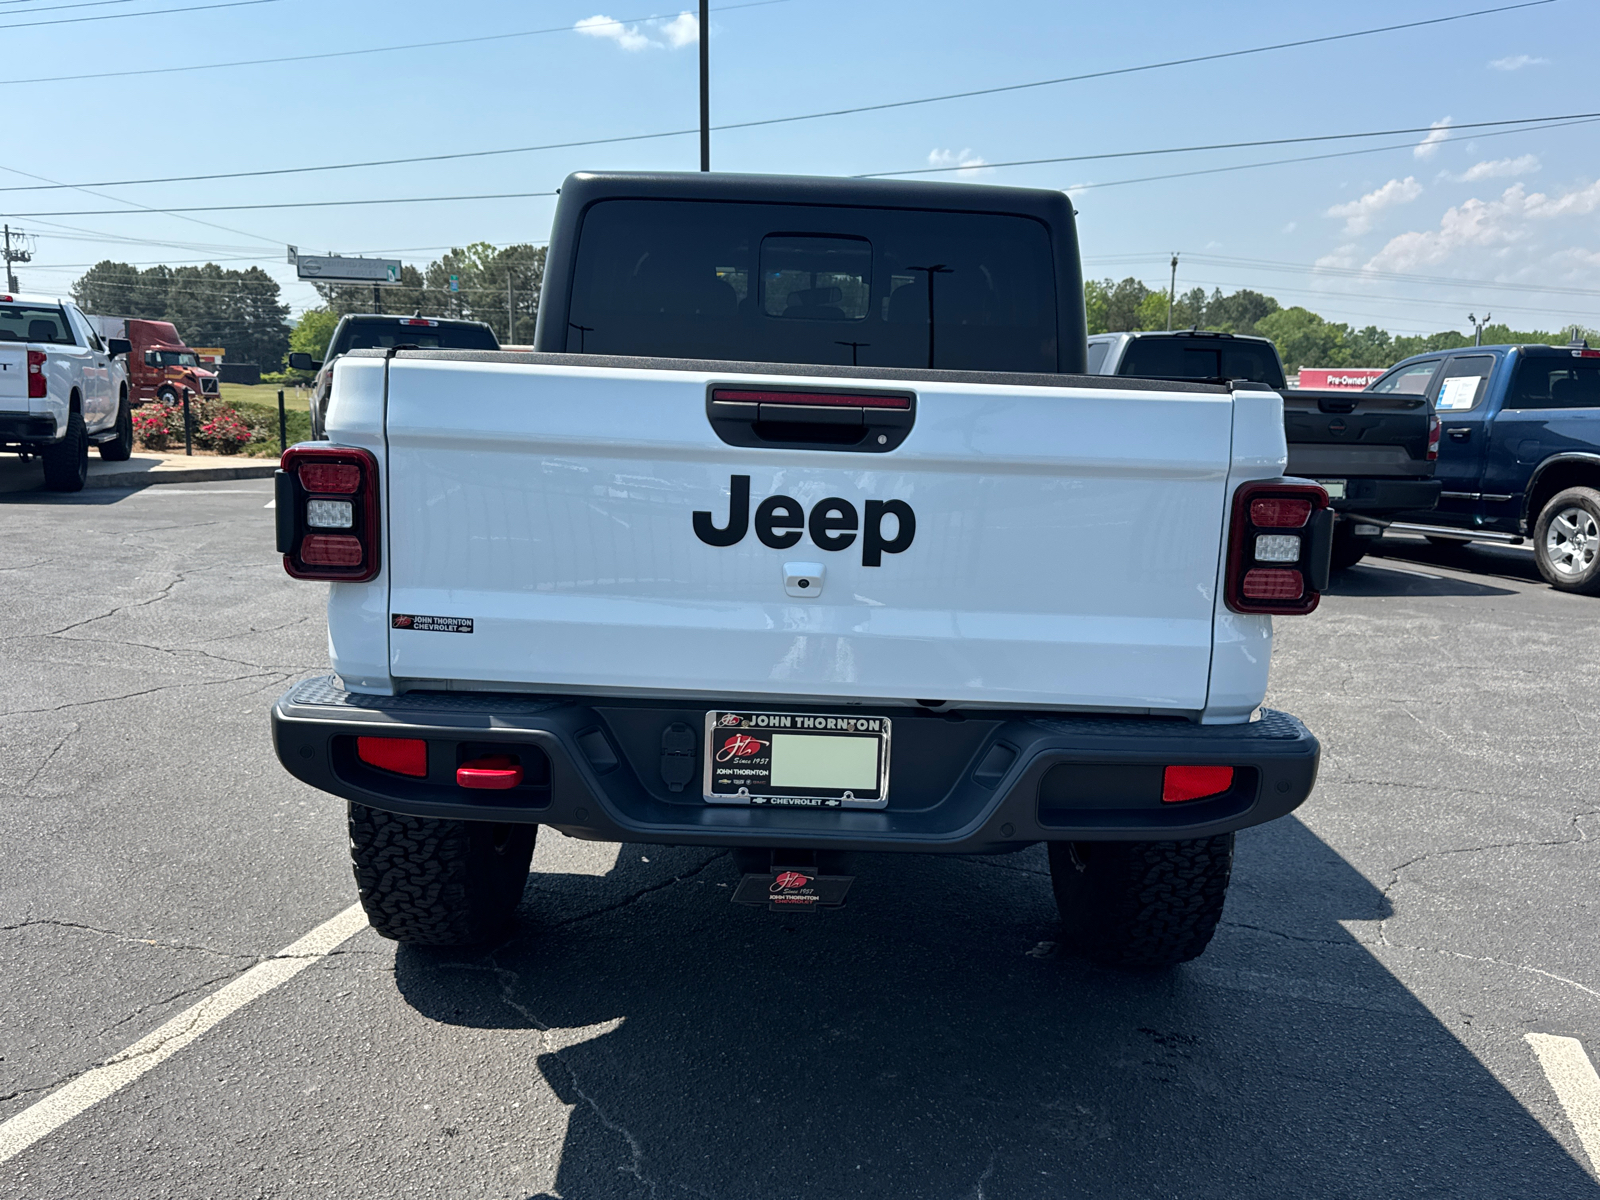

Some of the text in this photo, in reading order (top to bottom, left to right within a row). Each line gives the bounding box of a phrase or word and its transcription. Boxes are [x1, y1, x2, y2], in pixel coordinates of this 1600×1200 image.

[1327, 375, 1367, 385] Pre-Owned
[692, 474, 916, 567] Jeep
[433, 617, 472, 626] THORNTON
[413, 623, 458, 632] CHEVROLET
[749, 715, 880, 731] JOHN THORNTON
[770, 797, 822, 806] CHEVROLET
